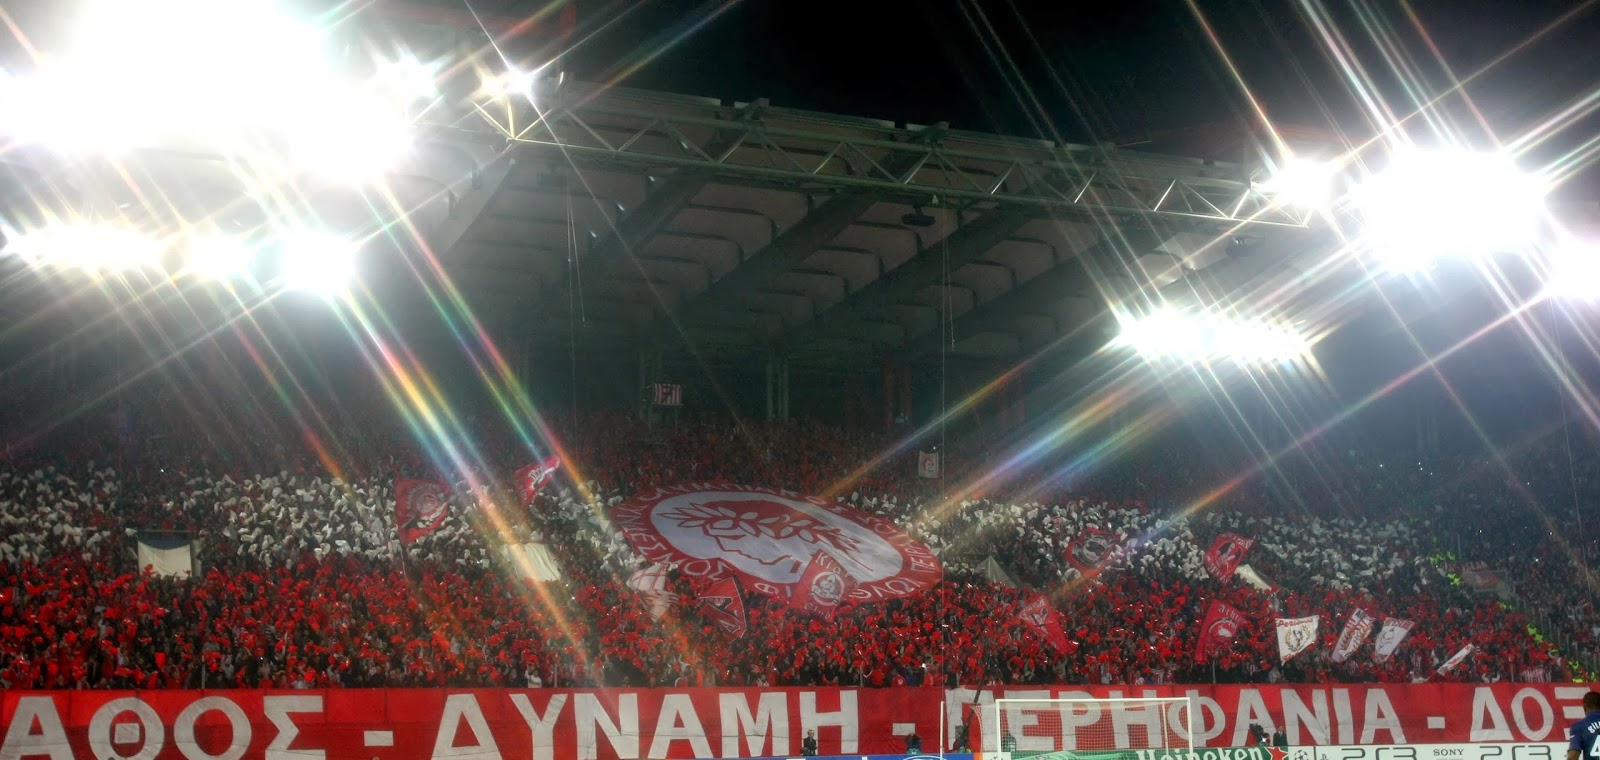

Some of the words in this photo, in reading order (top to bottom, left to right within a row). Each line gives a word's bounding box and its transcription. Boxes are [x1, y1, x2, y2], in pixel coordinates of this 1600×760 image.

[430, 690, 859, 760] ΔΥΝΑΜΗ
[945, 688, 1407, 748] ΠΕΡΗΦΑΝΙΑ
[1433, 748, 1465, 756] SONY
